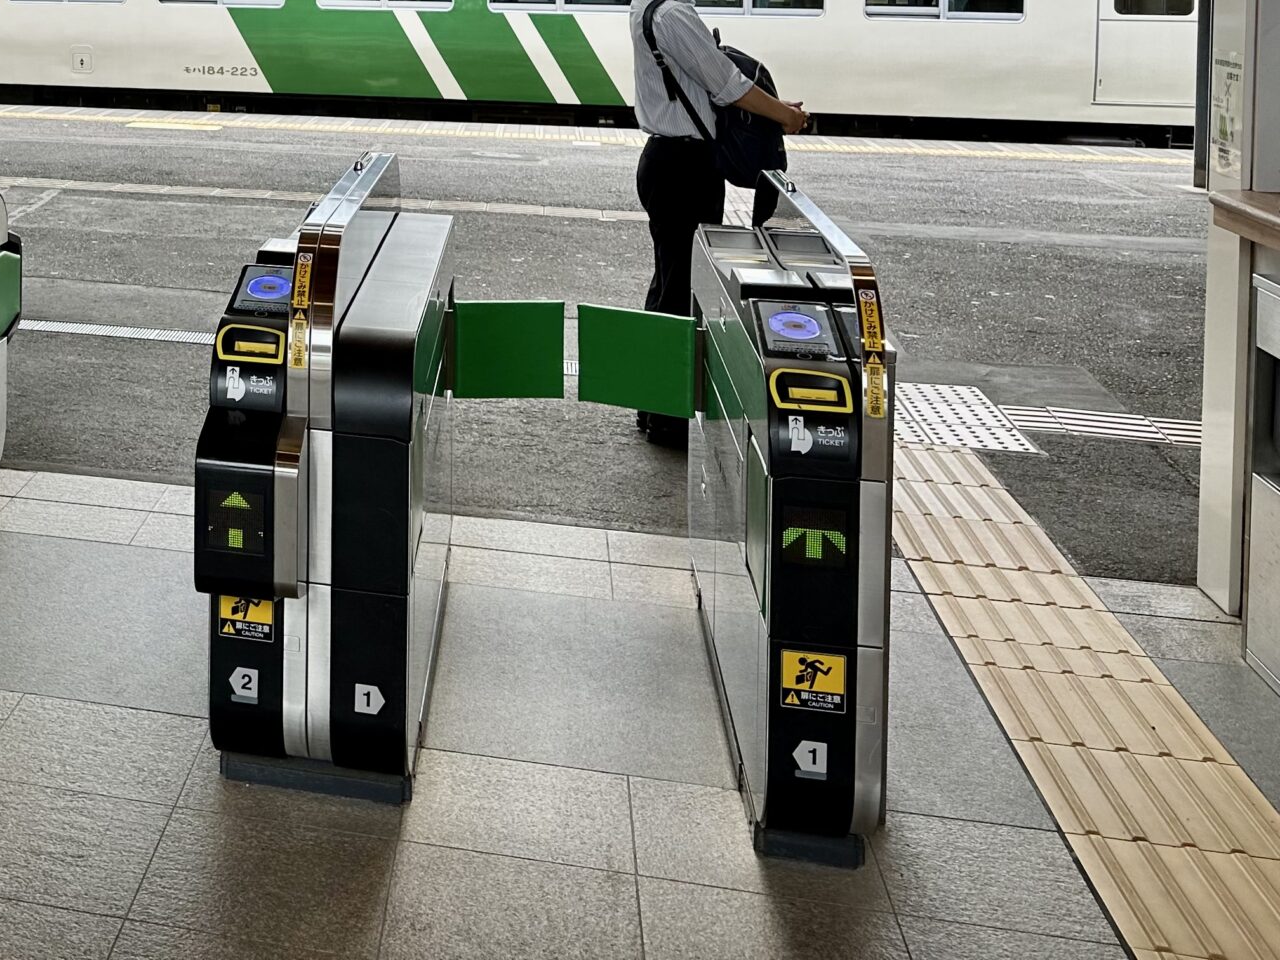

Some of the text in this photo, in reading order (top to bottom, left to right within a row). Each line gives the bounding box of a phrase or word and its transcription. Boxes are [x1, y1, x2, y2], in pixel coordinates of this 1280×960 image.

[296, 262, 310, 308] かけこみ禁止
[864, 300, 880, 350] かけこみ禁止
[250, 387, 273, 395] TICKET
[818, 438, 845, 448] TICKET
[241, 630, 264, 638] CAUTION
[241, 674, 252, 690] 2
[363, 691, 371, 707] 1
[807, 700, 834, 709] CAUTION
[808, 748, 817, 765] 1
